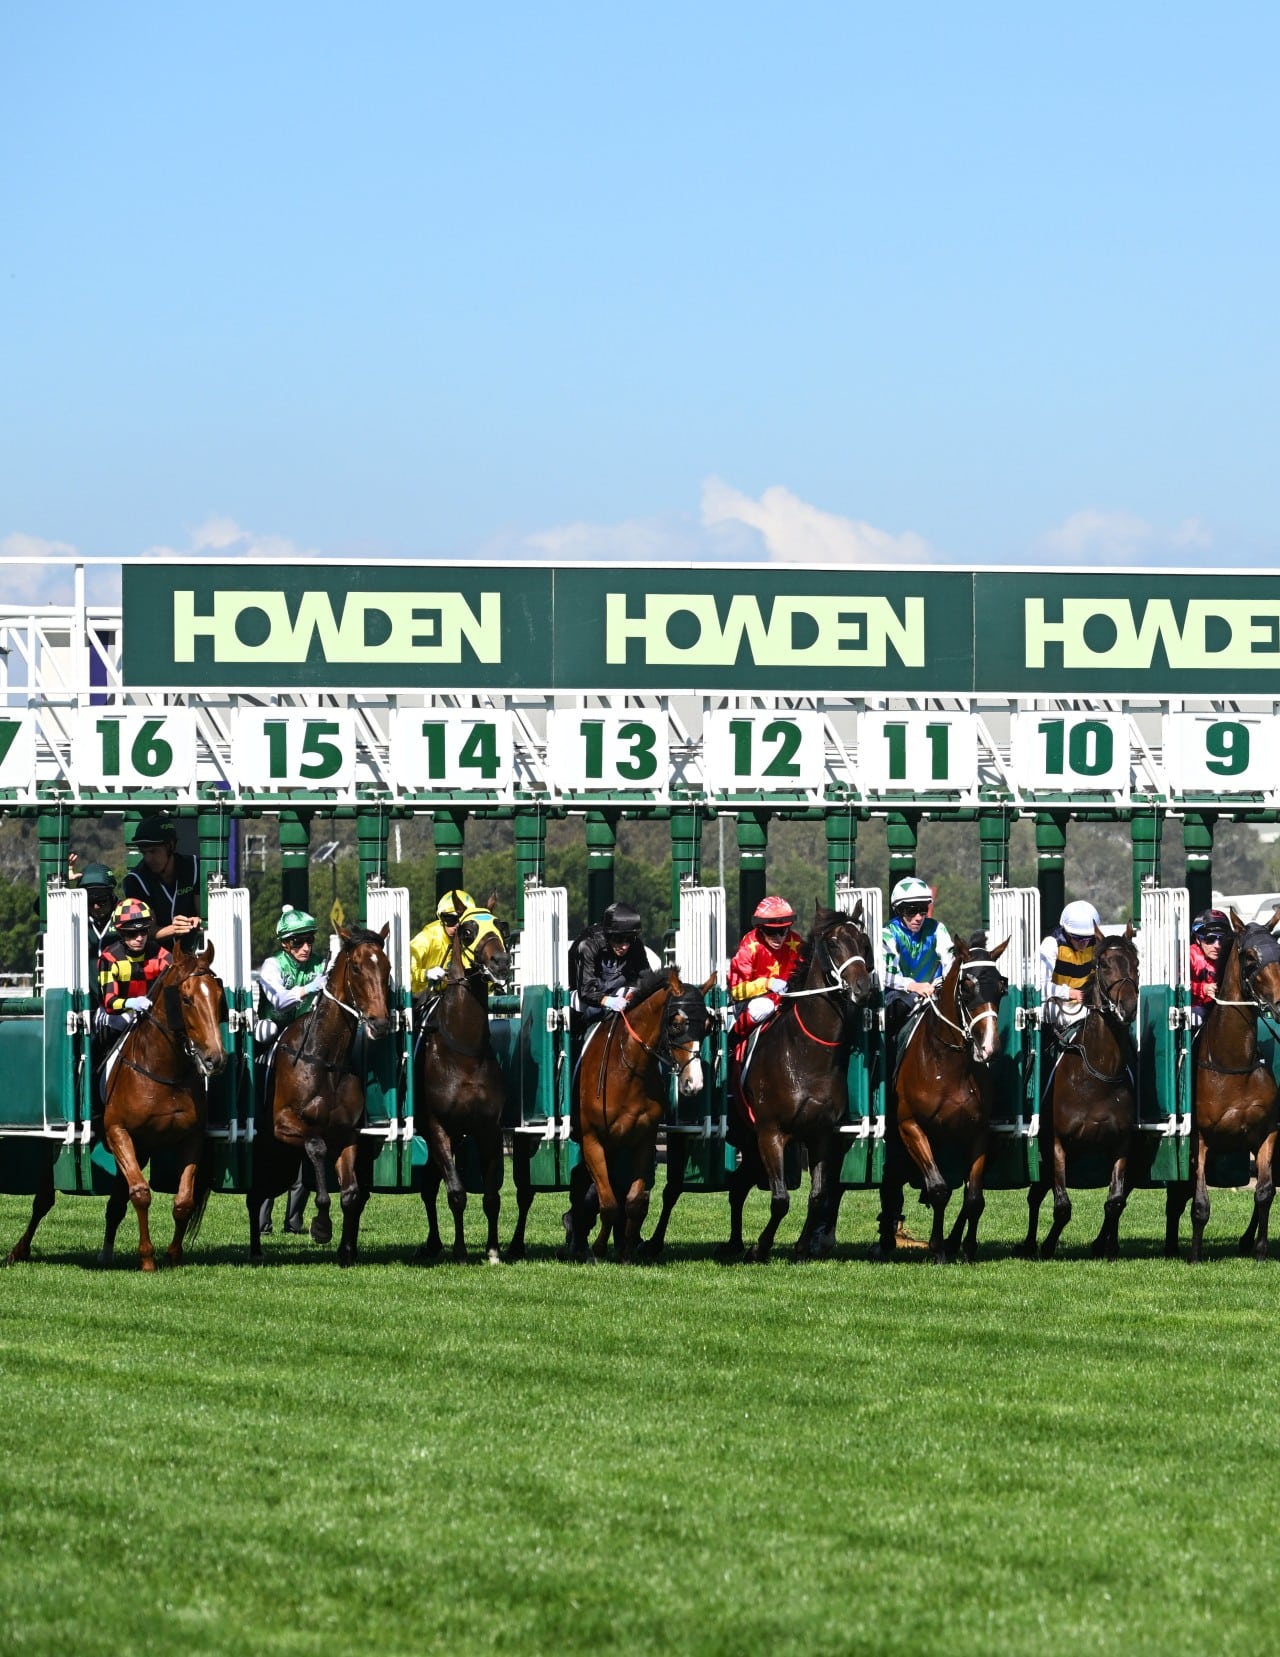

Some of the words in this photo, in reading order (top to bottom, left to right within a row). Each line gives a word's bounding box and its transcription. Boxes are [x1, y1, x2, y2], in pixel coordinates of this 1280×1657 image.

[174, 591, 500, 663] HOWDEN
[607, 594, 924, 666] HOWDEN
[97, 720, 172, 776] 16
[264, 722, 342, 779] 15
[422, 723, 500, 778] 14
[581, 722, 656, 779] 13
[729, 721, 801, 776] 12
[884, 725, 948, 779] 11
[1038, 721, 1112, 775] 10
[1207, 721, 1249, 776] 9
